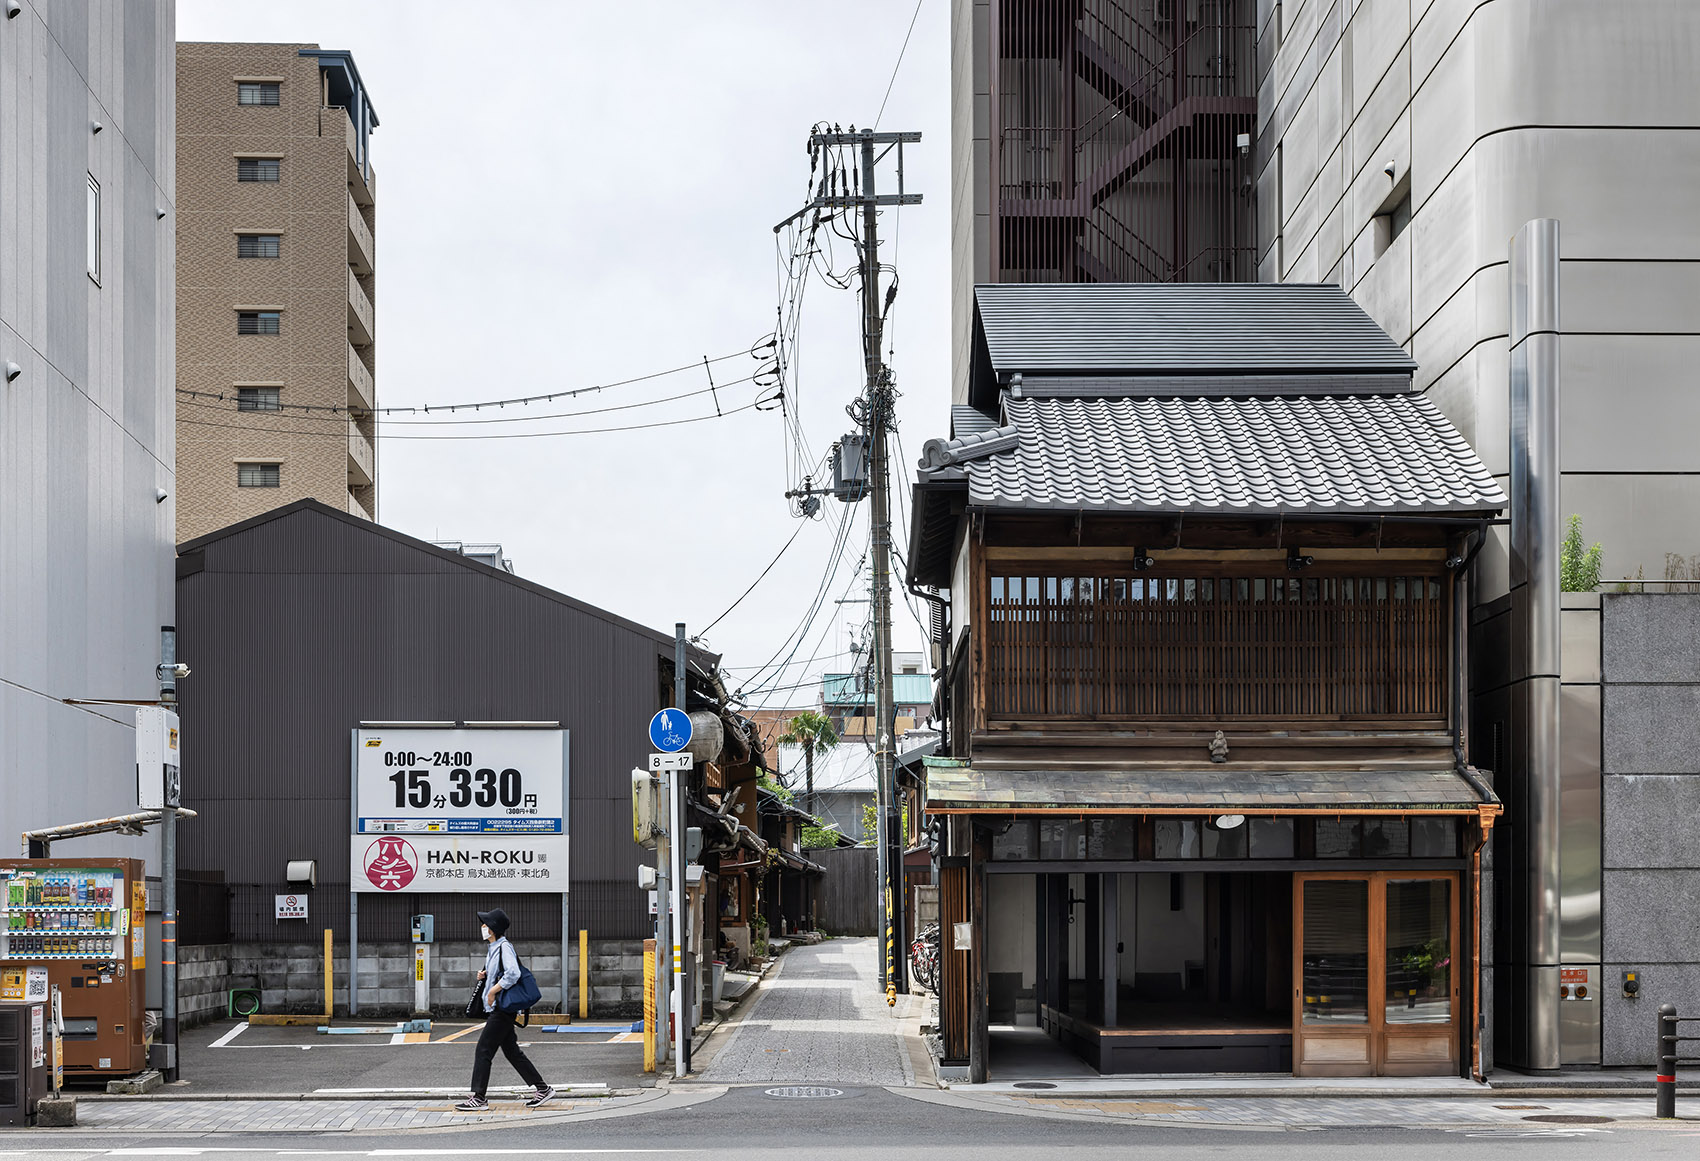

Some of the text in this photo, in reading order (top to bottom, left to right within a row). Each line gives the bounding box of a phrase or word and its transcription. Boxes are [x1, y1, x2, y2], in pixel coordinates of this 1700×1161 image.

[653, 757, 661, 767] 8
[678, 756, 689, 766] 17
[427, 850, 534, 864] HAN-ROKU
[425, 868, 464, 878] 京都本店
